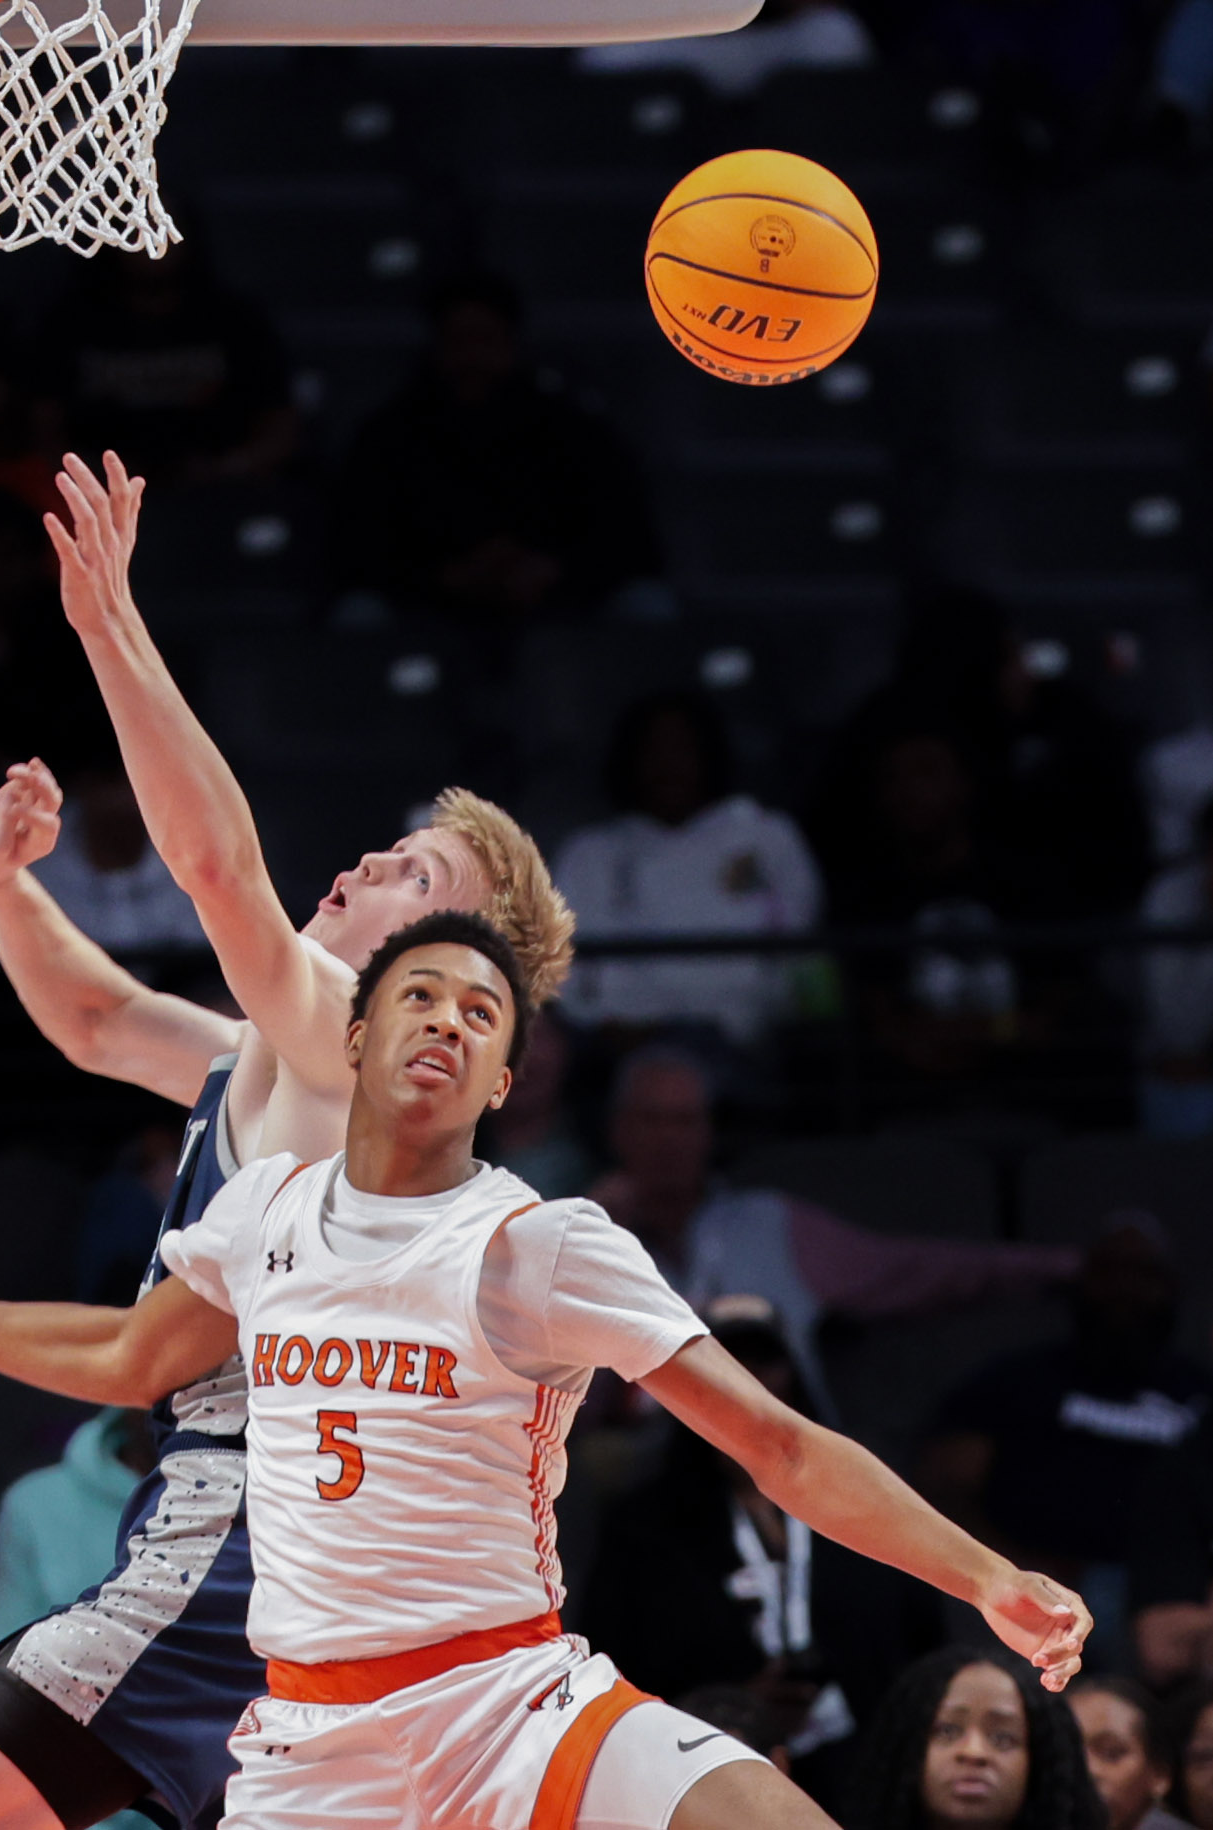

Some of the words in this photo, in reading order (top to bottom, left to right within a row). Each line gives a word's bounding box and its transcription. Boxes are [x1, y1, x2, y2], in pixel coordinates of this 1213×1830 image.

[681, 303, 708, 321] NXT
[708, 303, 802, 343] EVO
[252, 1333, 460, 1399] HOOVER
[315, 1409, 365, 1501] 5
